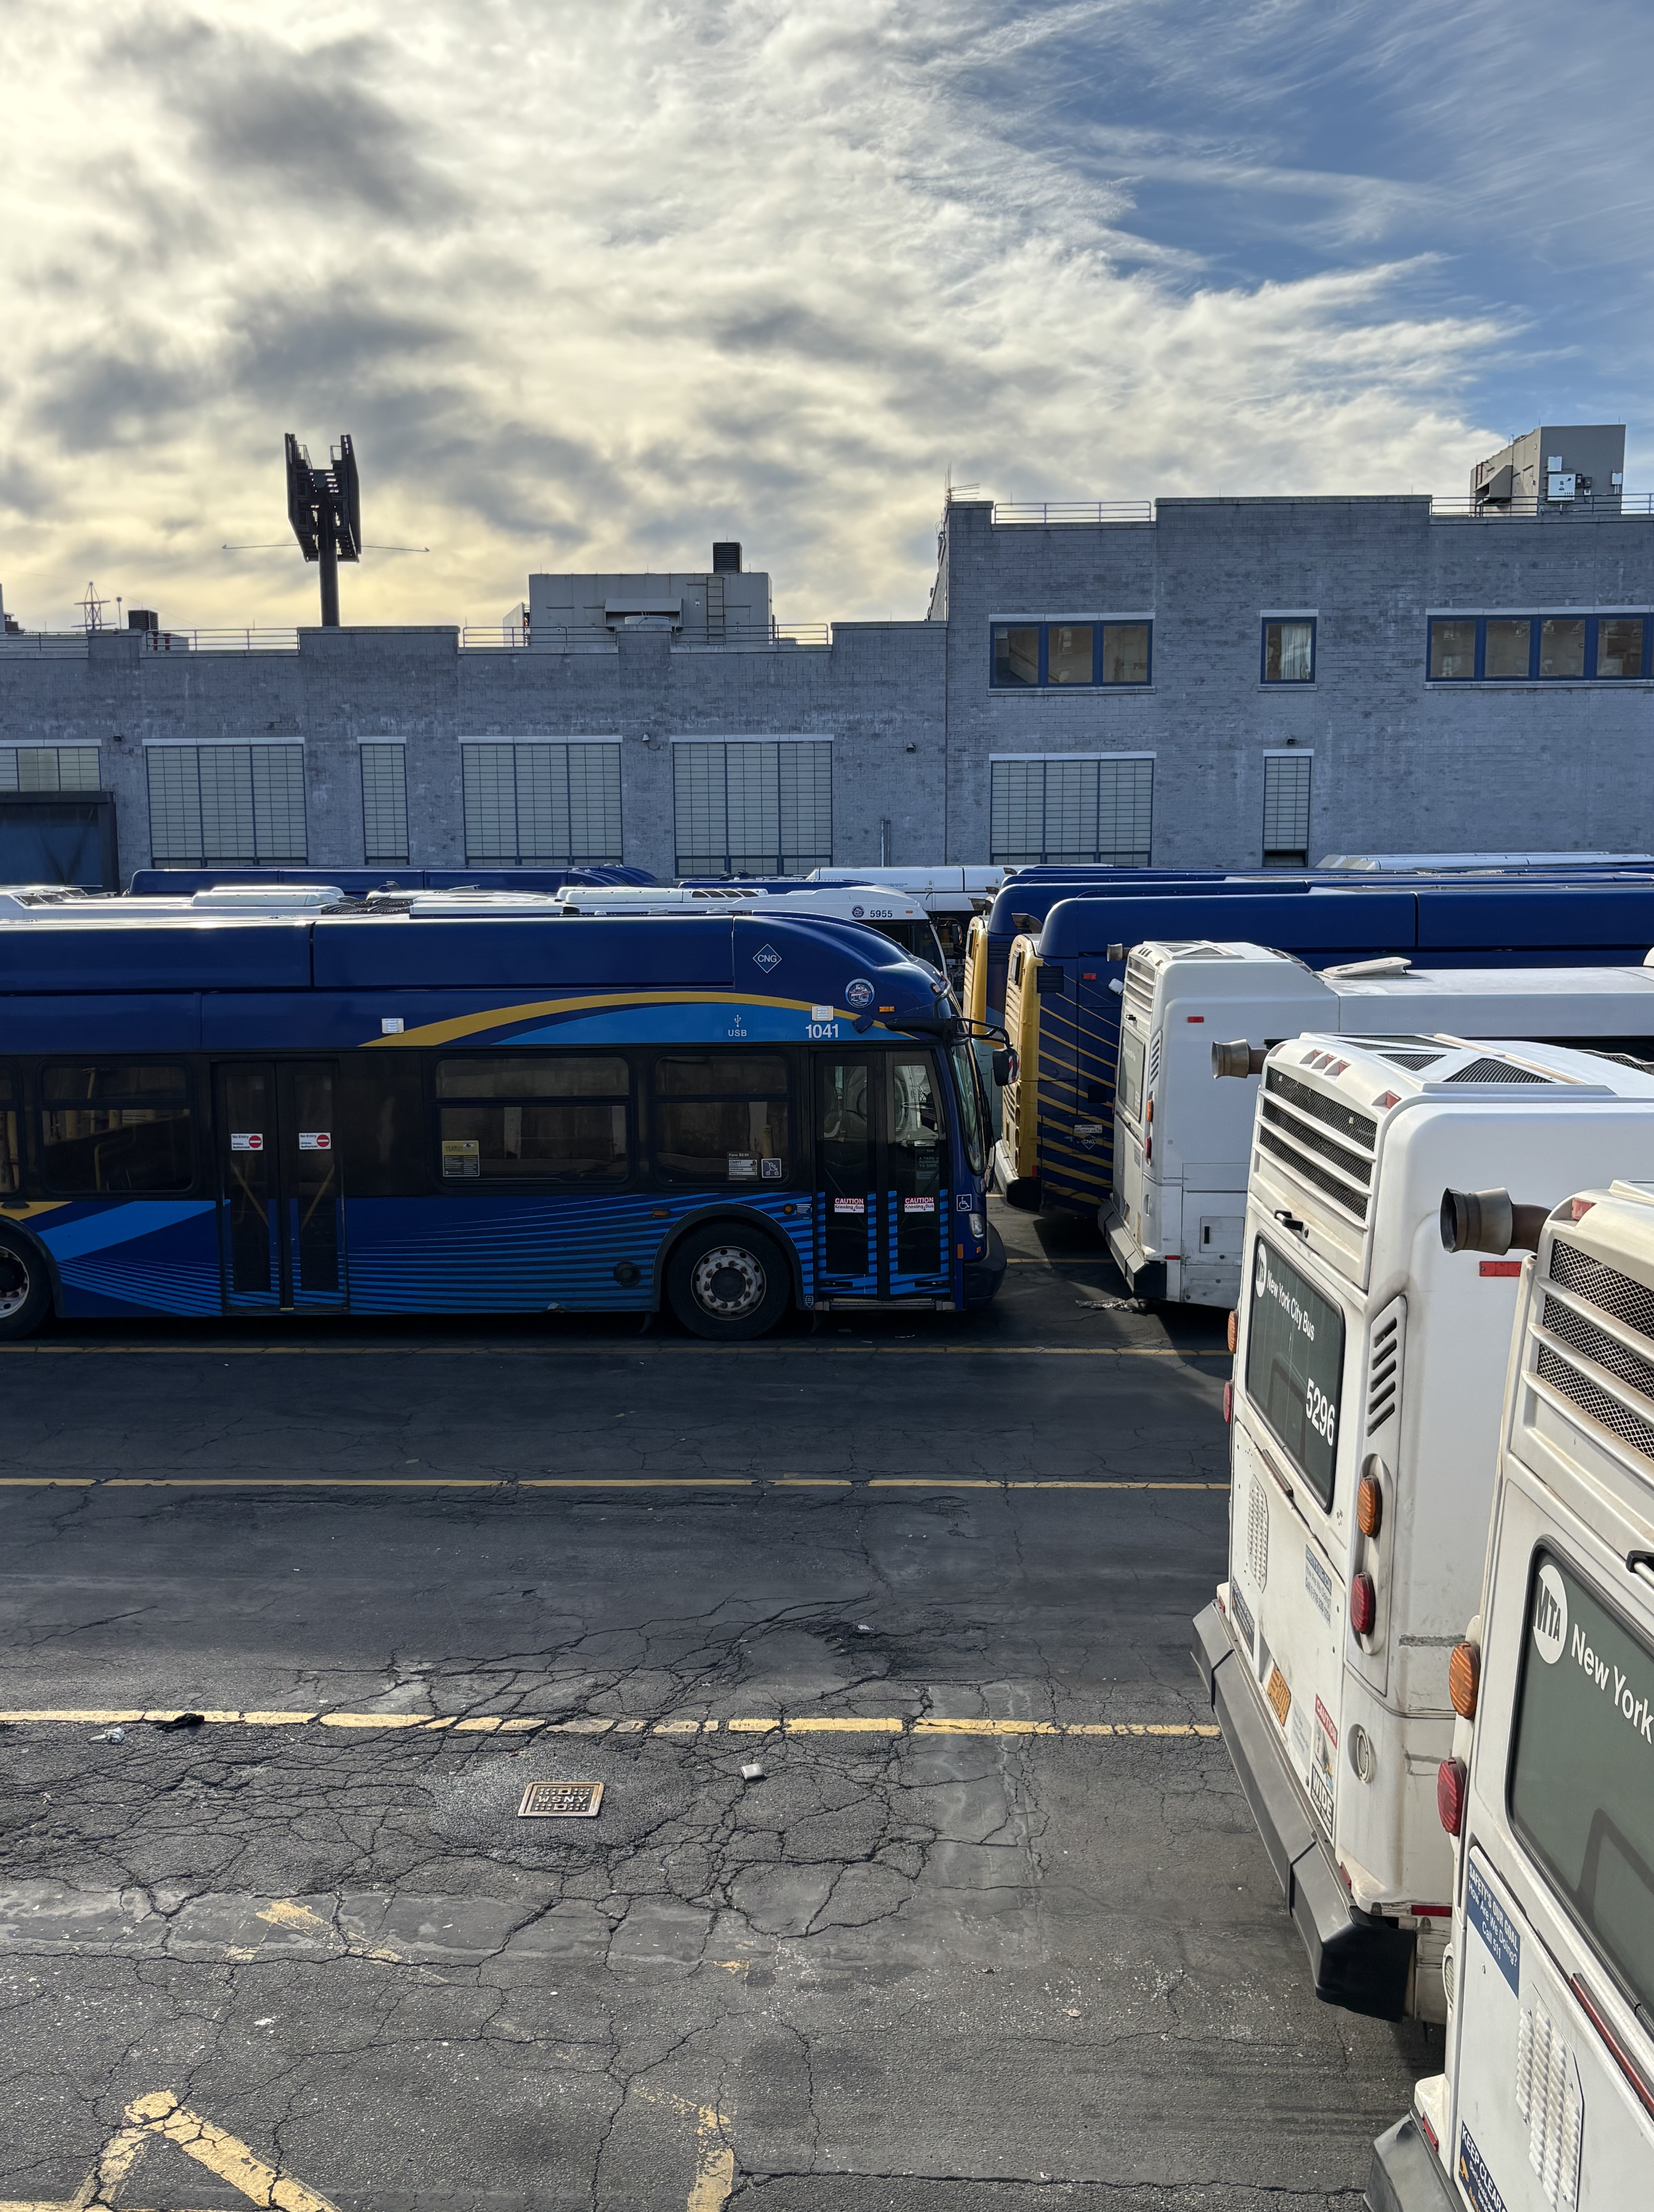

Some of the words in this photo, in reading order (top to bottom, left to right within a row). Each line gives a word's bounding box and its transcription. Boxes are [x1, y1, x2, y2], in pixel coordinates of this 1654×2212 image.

[805, 1024, 838, 1039] 1041
[1267, 1270, 1278, 1298] New
[1278, 1282, 1290, 1314] York
[1291, 1298, 1302, 1330] City
[1302, 1311, 1315, 1341] Bus
[1306, 1377, 1335, 1446] 5296
[1534, 1585, 1561, 1642] MTA
[1571, 1623, 1609, 1691] New
[1614, 1665, 1654, 1744] York
[1316, 1699, 1337, 1743] CAUTION
[1313, 1767, 1332, 1823] WIDE
[1469, 1864, 1492, 1908] SAFETY'S
[1493, 1901, 1503, 1927] OUR
[1505, 1920, 1518, 1952] GOAL
[1469, 1880, 1479, 1905] How
[1480, 1900, 1489, 1921] Are
[1490, 1913, 1498, 1936] We
[1499, 1929, 1518, 1966] Doing?
[1482, 1921, 1492, 1944] Call
[1493, 1938, 1501, 1959] 511
[1462, 2125, 1479, 2165] KEEP
[1480, 2162, 1501, 2212] CLEAR
